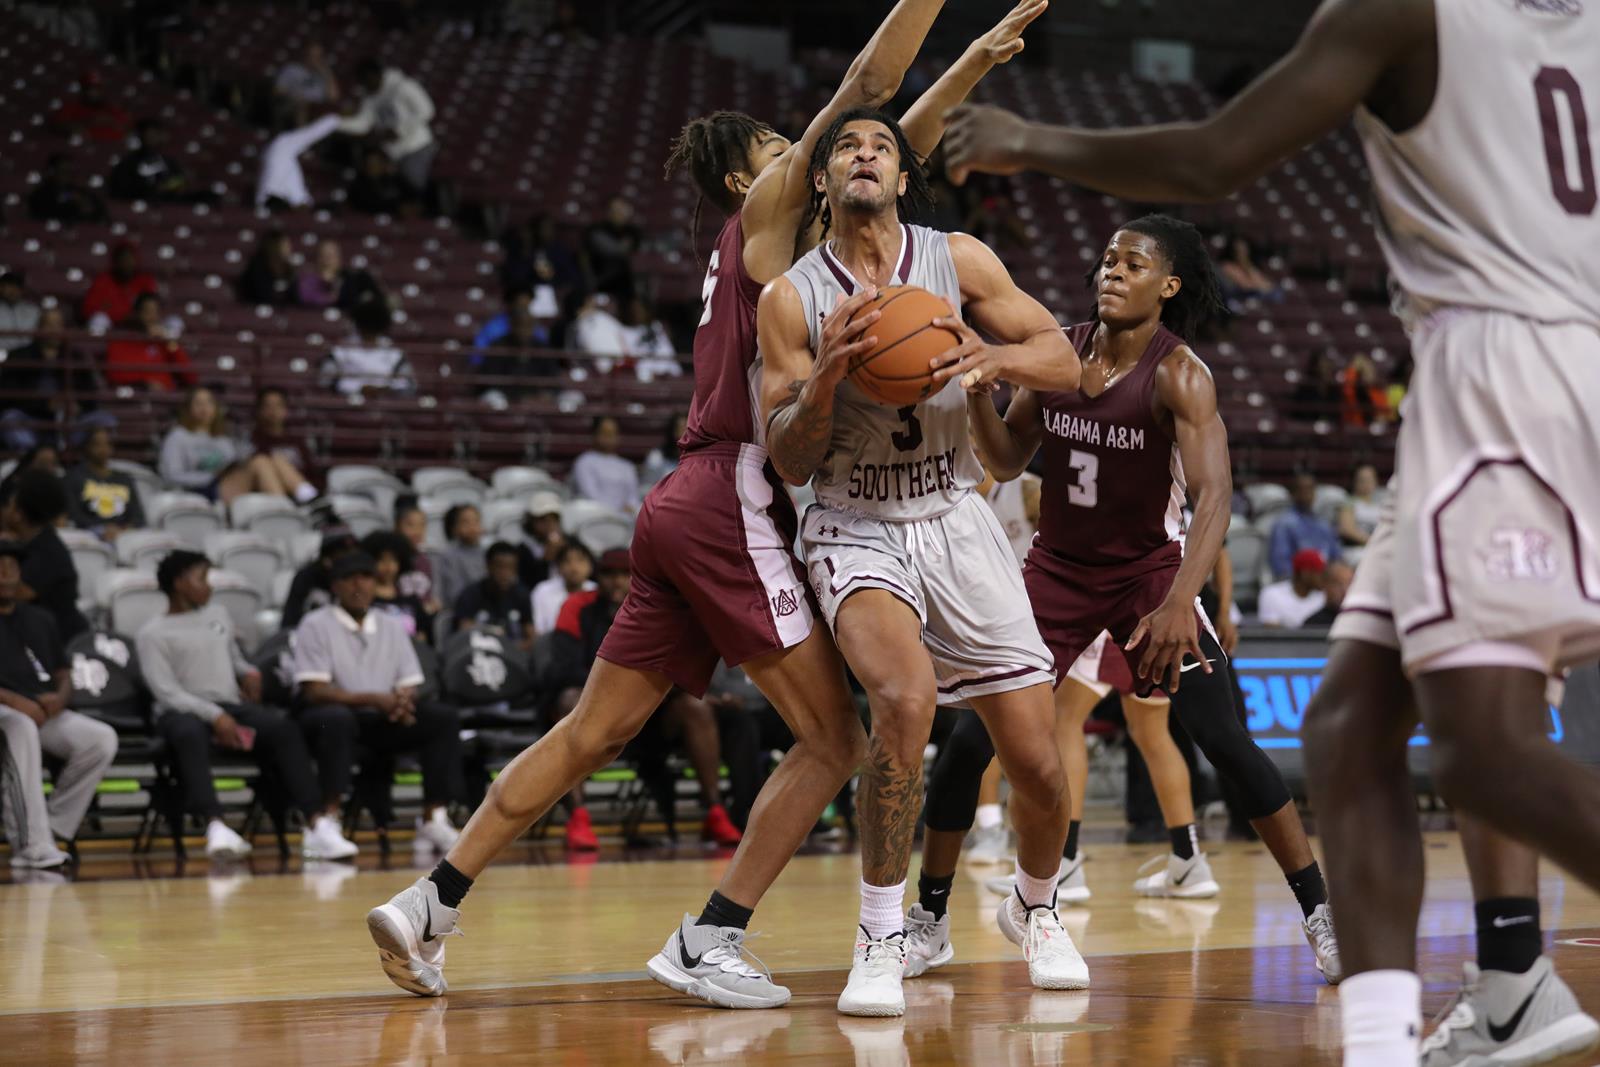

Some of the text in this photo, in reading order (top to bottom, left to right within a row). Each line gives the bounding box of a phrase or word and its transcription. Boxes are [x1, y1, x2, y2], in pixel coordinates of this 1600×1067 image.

[1533, 65, 1597, 216] 0
[891, 403, 923, 452] 3
[1106, 424, 1144, 450] A&M
[1067, 449, 1099, 508] 3
